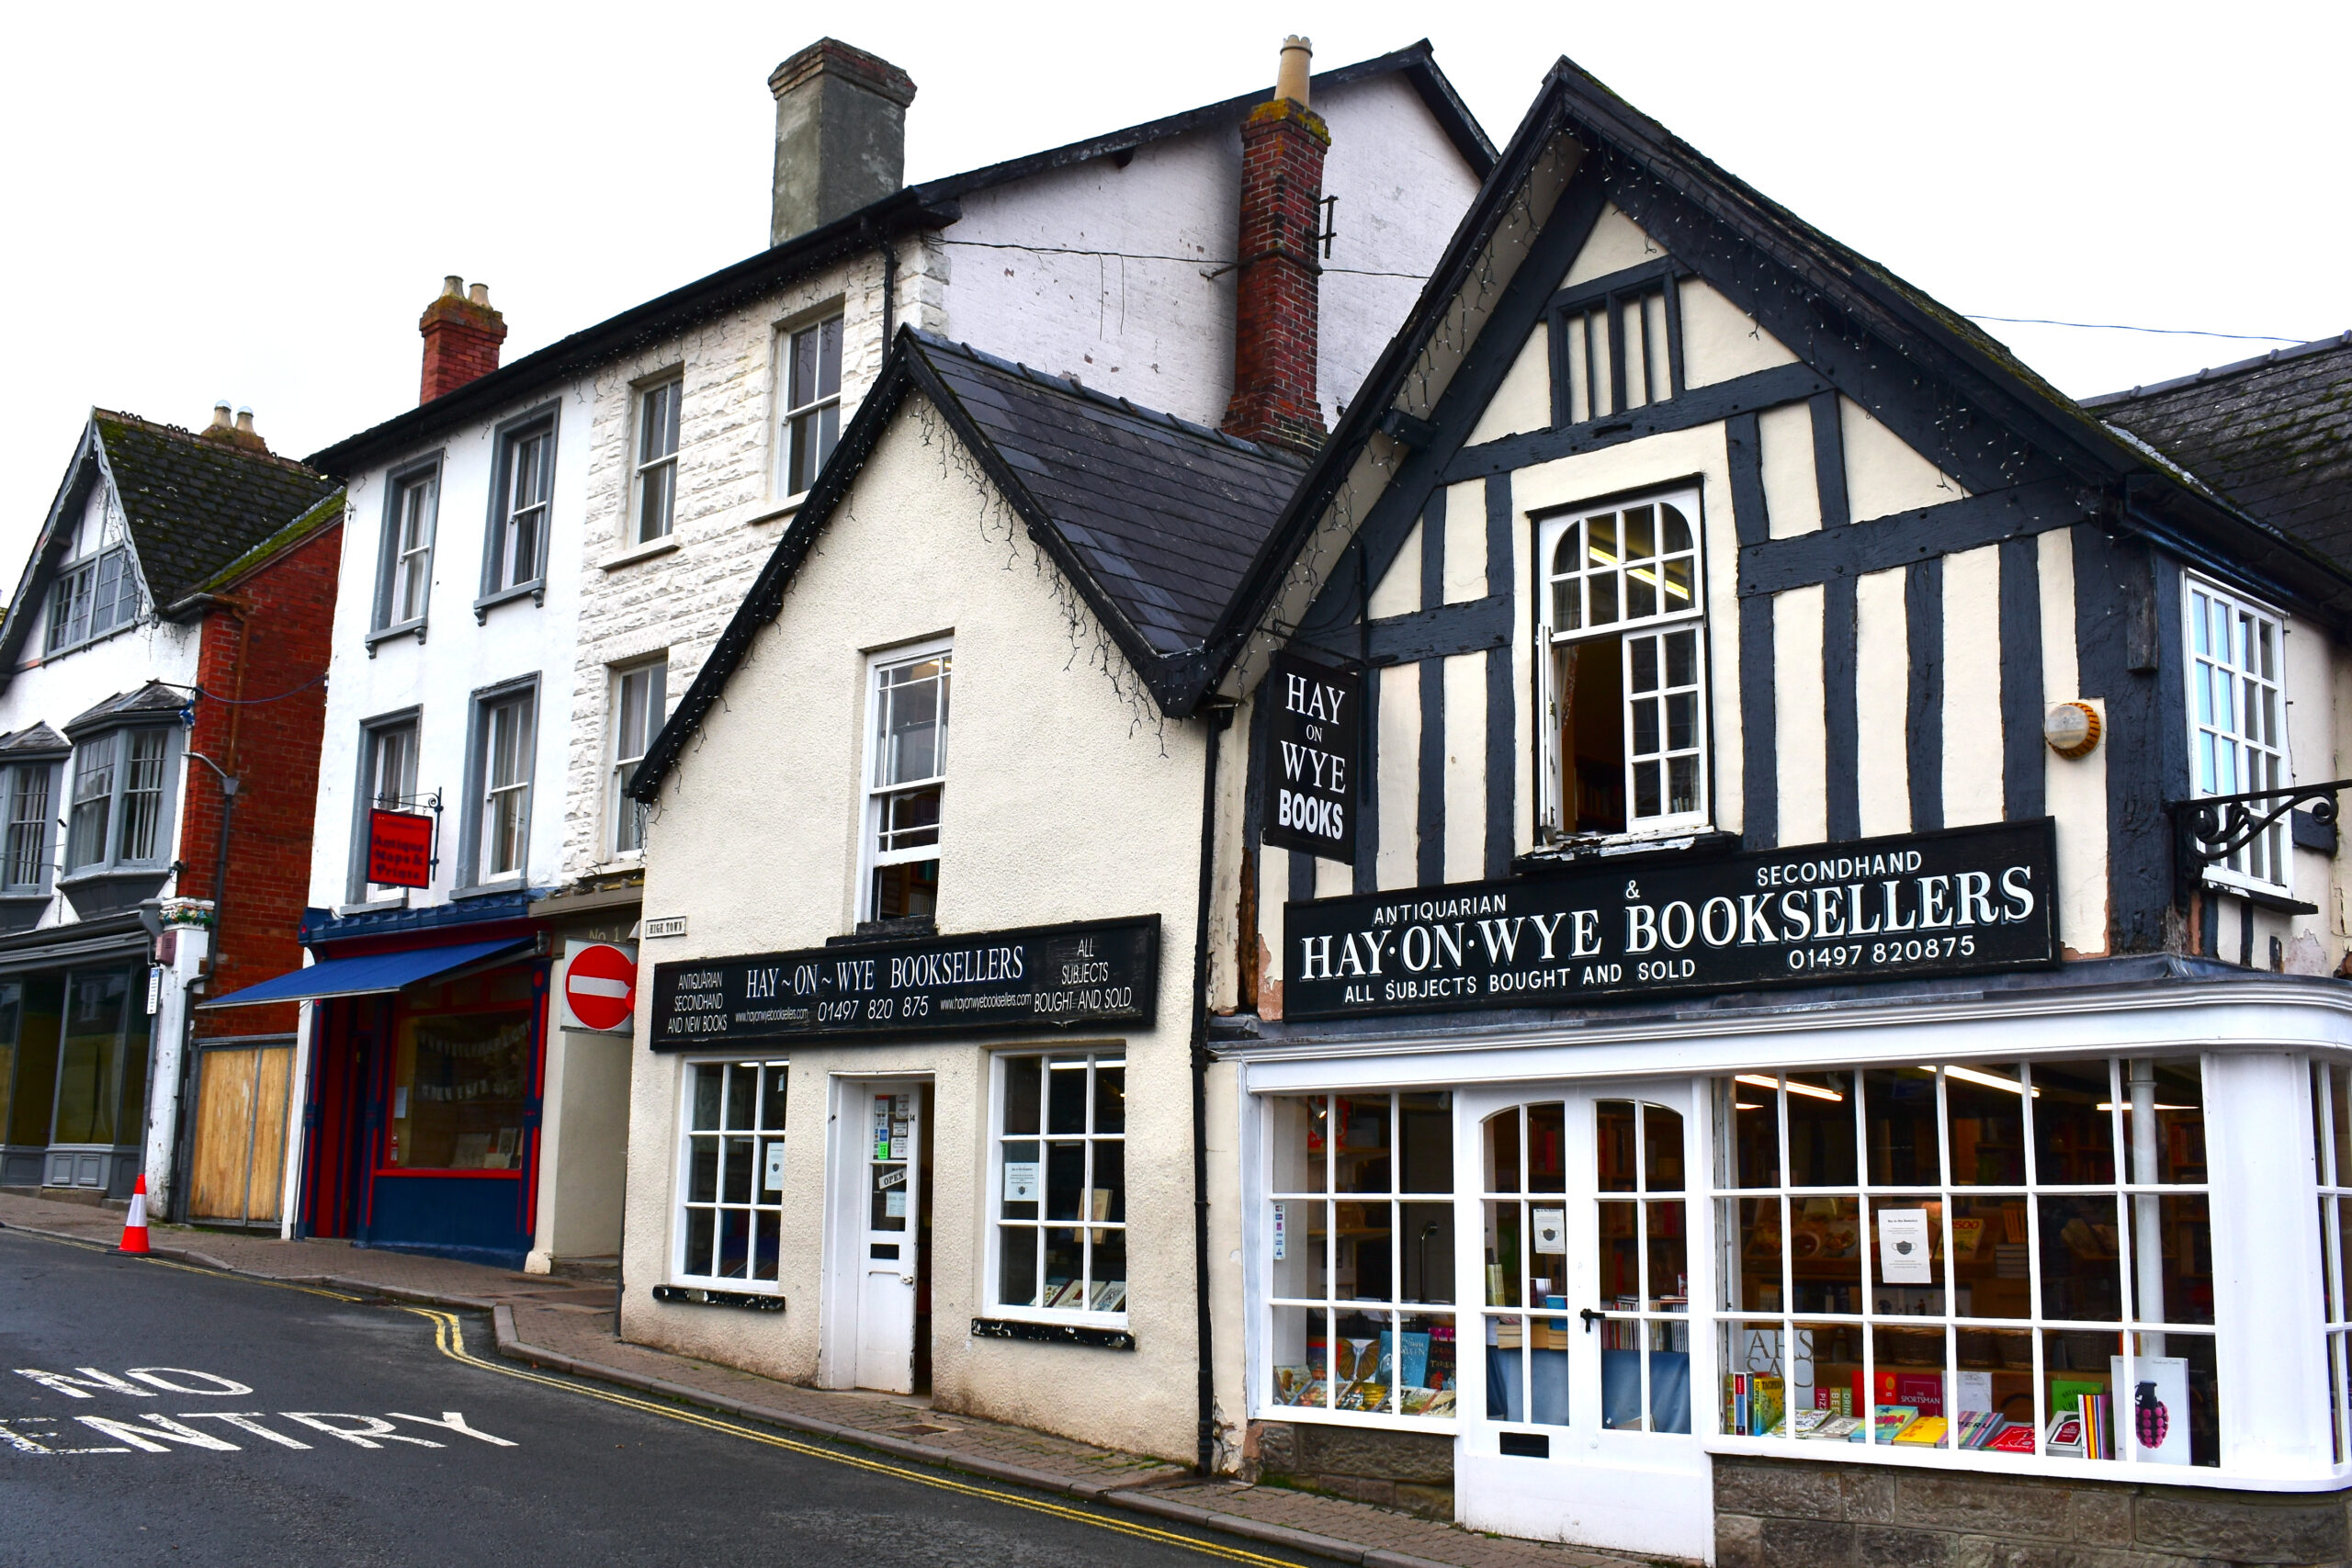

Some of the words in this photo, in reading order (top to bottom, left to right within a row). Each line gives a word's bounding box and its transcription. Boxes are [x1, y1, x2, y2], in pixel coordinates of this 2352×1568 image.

[1285, 672, 1345, 725] HAY
[1306, 724, 1323, 743] ON
[1280, 740, 1346, 794] WYE
[1278, 788, 1343, 840] BOOKS
[1373, 894, 1507, 925] ANTIQUARIAN
[1625, 879, 1641, 899] &
[1757, 850, 1922, 887] SECONDHAND
[1624, 865, 2034, 954] BOOKSELLERS
[649, 921, 663, 934] HIGH
[665, 920, 683, 932] TOWN
[1077, 938, 1094, 958] ALL
[1788, 945, 1861, 970] 01497
[1872, 934, 1975, 963] 820875
[889, 945, 1023, 988] BOOKSELLERS
[1061, 961, 1109, 986] SUBJECTS
[677, 970, 723, 990] ANTIQUARIAN
[1344, 984, 1374, 1003] ALL
[1385, 976, 1477, 1001] SUBJECTS
[1489, 968, 1571, 993] BOUGHT
[1582, 963, 1623, 985] AND
[1638, 958, 1696, 981] SOLD
[673, 992, 724, 1012] SECONDHAND
[818, 999, 859, 1021] 01497
[867, 998, 893, 1020] 820
[902, 995, 929, 1017] 875
[1034, 991, 1074, 1012] BOUGHT
[1078, 989, 1102, 1010] AND
[1104, 987, 1132, 1009] SOLD
[667, 1017, 683, 1034] AND
[684, 1016, 701, 1032] NEW
[702, 1014, 728, 1032] BOOKS
[883, 1170, 904, 1186] OPEN
[13, 1367, 254, 1398] NO
[1900, 1395, 1940, 1404] SPORTSMAN
[0, 1411, 520, 1453] ENTRY
